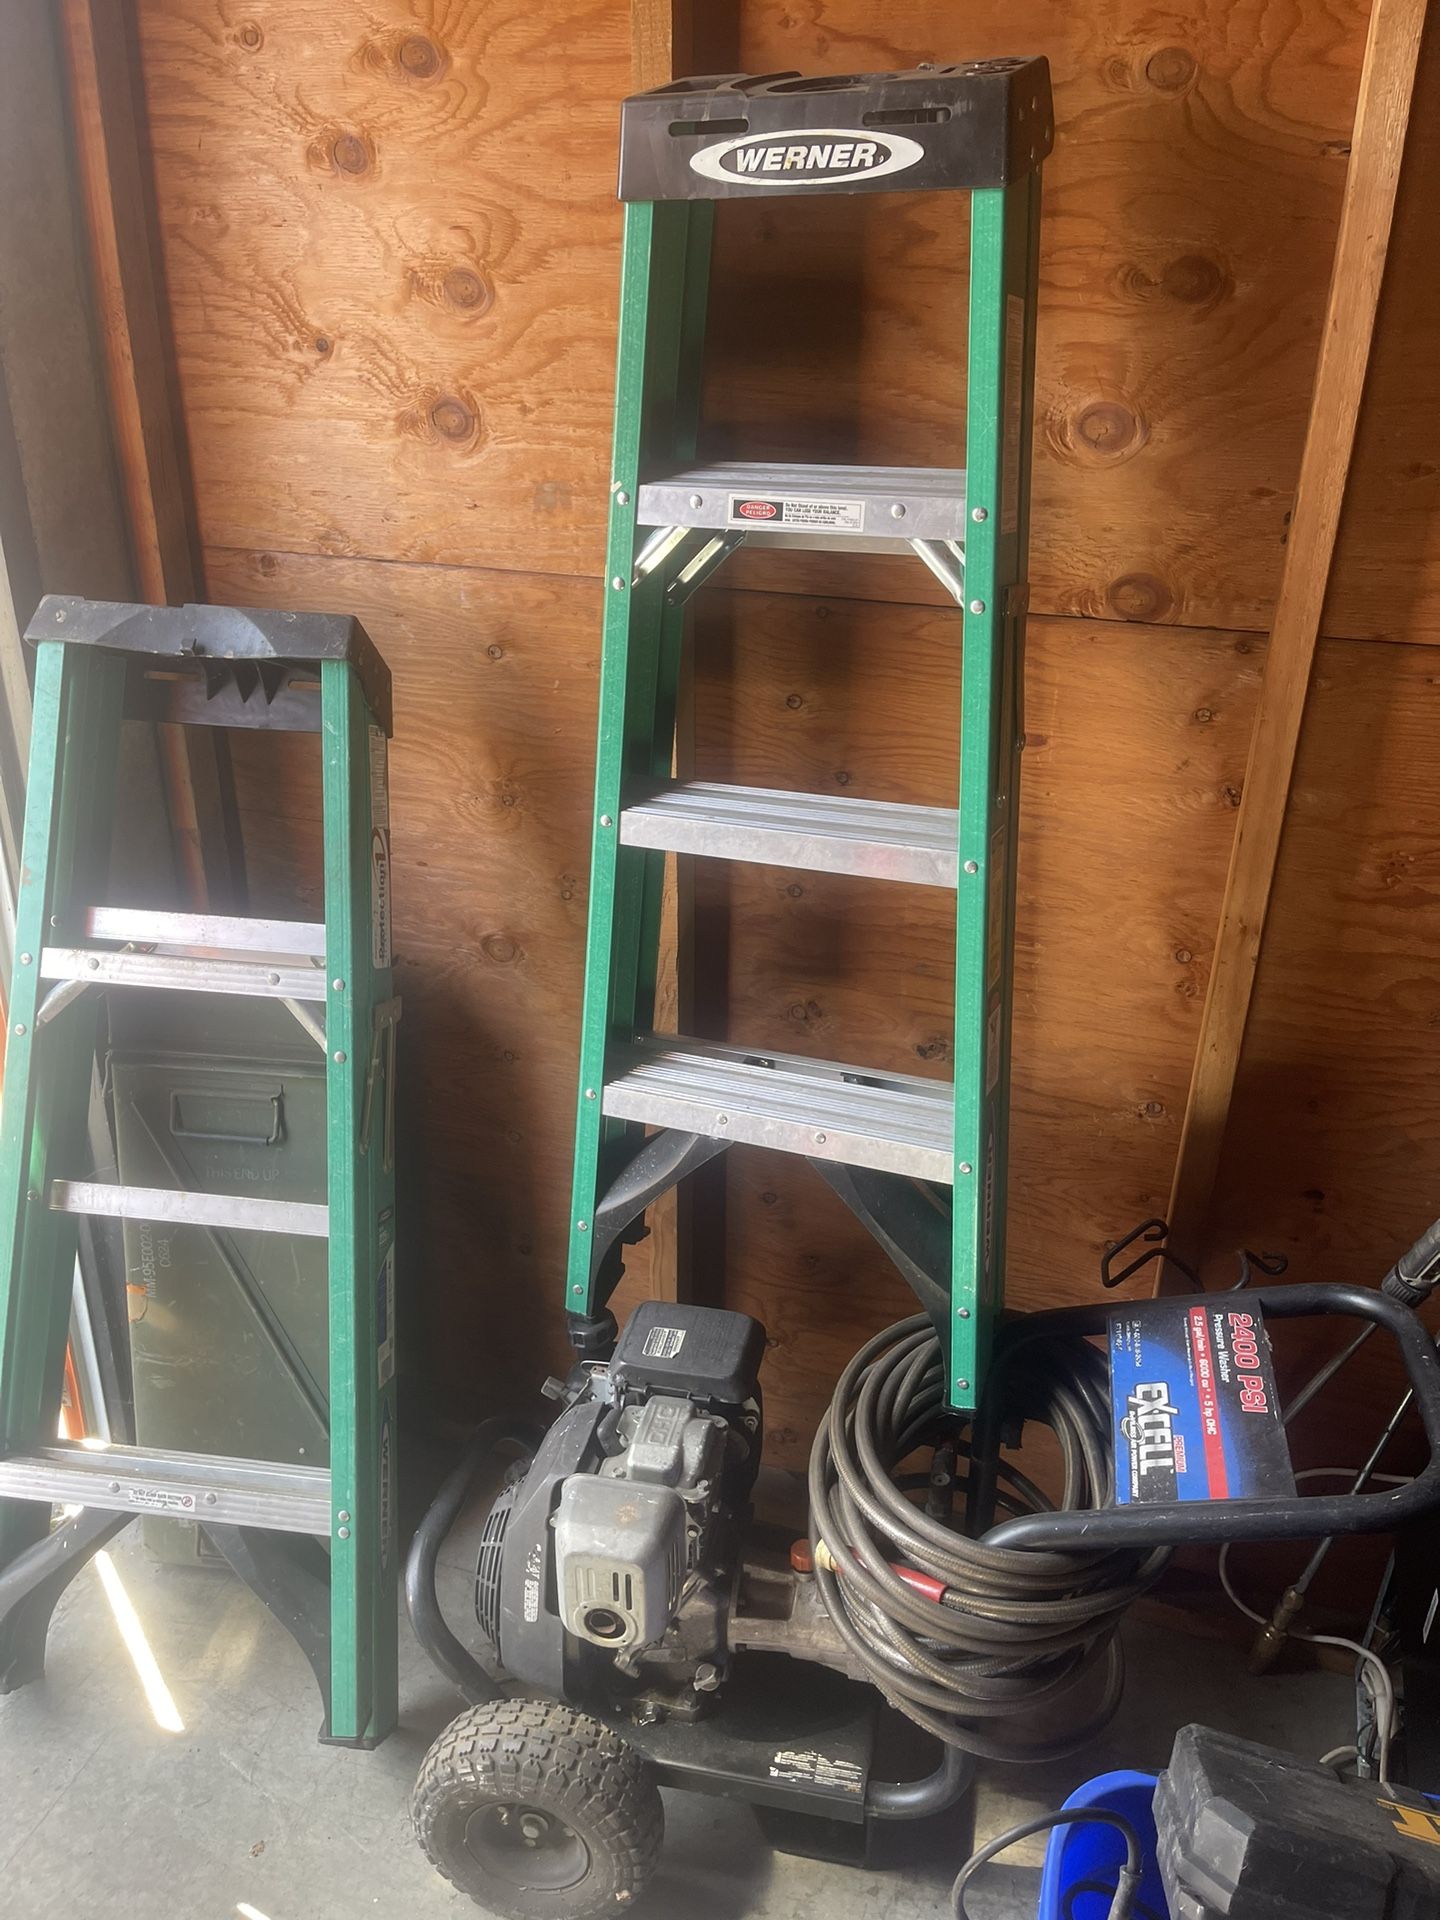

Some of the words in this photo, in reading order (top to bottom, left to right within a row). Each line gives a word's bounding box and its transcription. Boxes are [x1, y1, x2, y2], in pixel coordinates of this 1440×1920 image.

[736, 142, 877, 172] WERNER
[263, 1168, 280, 1181] UP
[1213, 1314, 1225, 1349] Pressure
[1228, 1313, 1260, 1369] 2400
[1218, 1351, 1231, 1383] Washer
[1237, 1375, 1268, 1413] PSI
[1202, 1408, 1214, 1417] hp
[1206, 1418, 1217, 1435] OHC
[1174, 1435, 1186, 1472] PREMIUM
